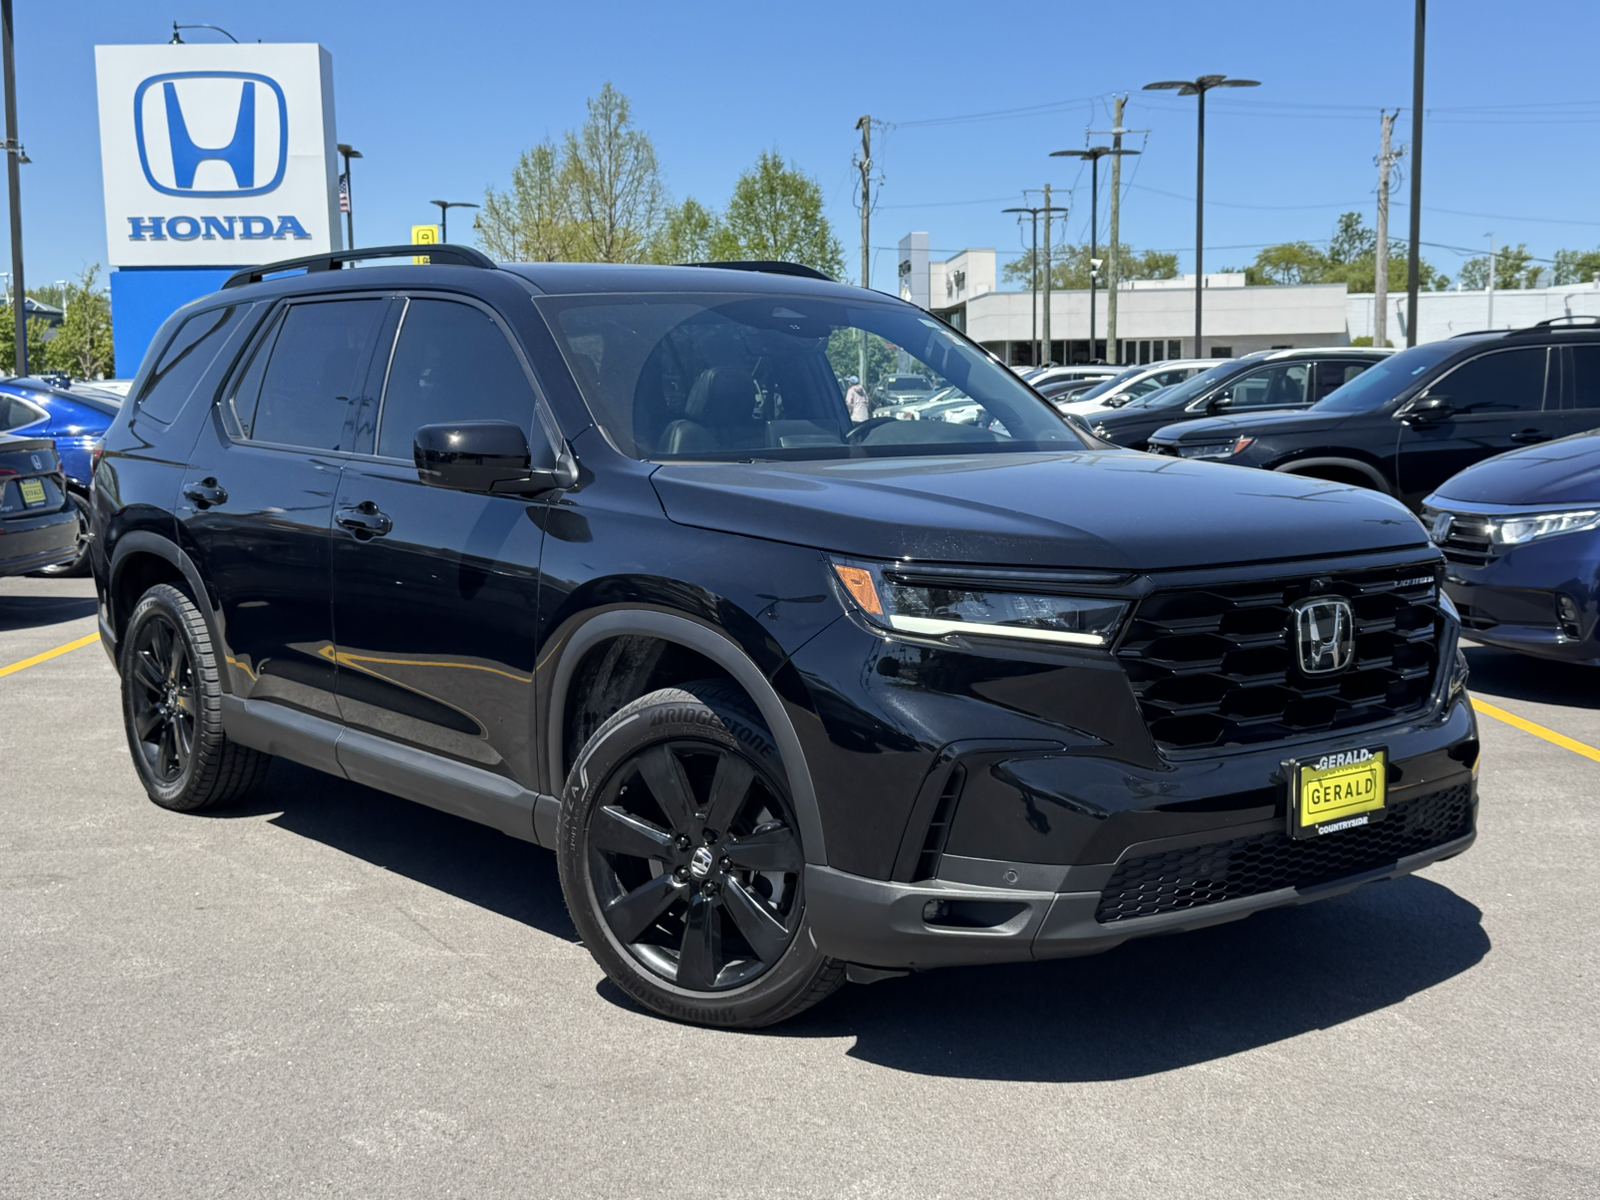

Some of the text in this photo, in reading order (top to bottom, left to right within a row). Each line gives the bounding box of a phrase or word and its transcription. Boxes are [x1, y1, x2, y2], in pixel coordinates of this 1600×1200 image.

[126, 215, 313, 242] HONDA
[649, 707, 776, 758] BRIDGESTONE
[1319, 748, 1369, 770] GERALD
[1311, 778, 1373, 805] GERALD
[1318, 816, 1369, 835] COUNTRYSIDE
